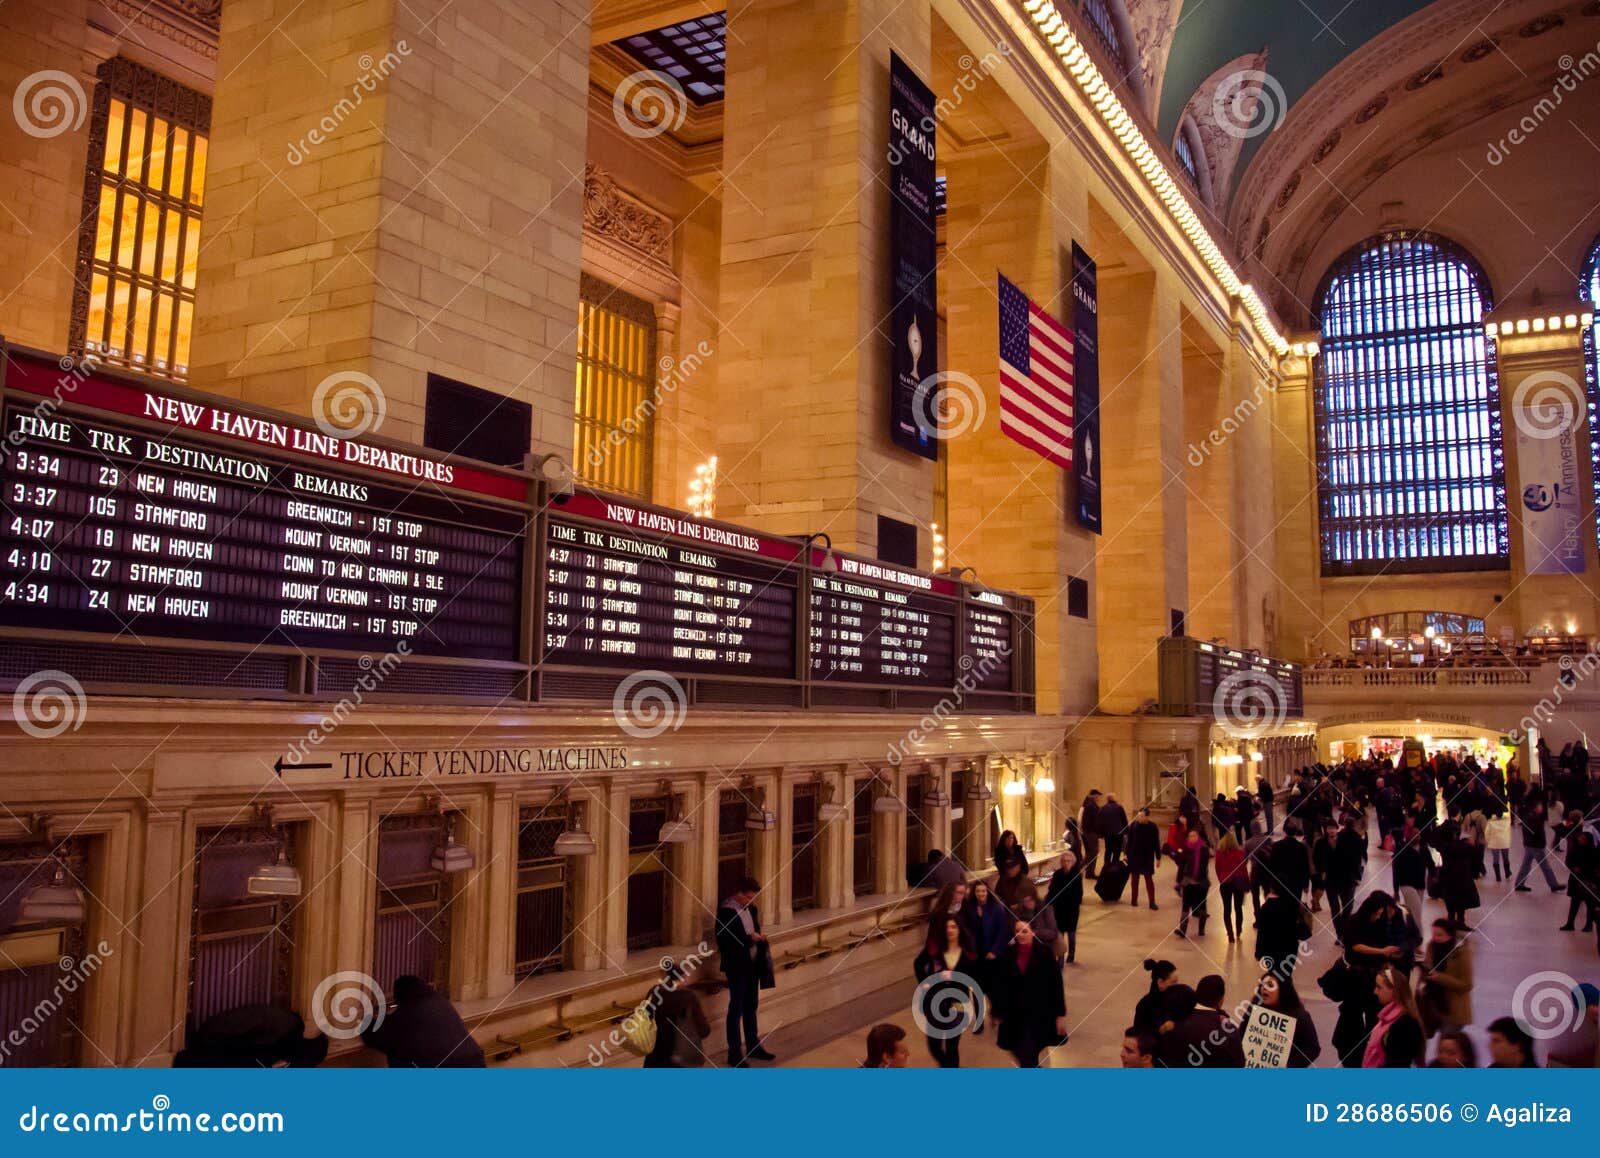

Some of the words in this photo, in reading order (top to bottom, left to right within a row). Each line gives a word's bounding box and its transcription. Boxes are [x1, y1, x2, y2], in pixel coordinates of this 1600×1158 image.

[892, 108, 935, 161] GRAND
[1073, 282, 1097, 313] GRAND
[16, 415, 71, 443] TIME
[88, 430, 133, 455] TRK
[145, 441, 270, 483] DESTINATION
[294, 473, 368, 502] REMARKS
[144, 393, 204, 426] NEW
[211, 409, 287, 447] HAVEN
[292, 428, 340, 458] LINE
[344, 441, 454, 484] DEPARTURES
[16, 452, 60, 476] 3:34
[99, 467, 118, 487] 23
[137, 473, 165, 494] NEW
[173, 480, 216, 504] HAVEN
[287, 501, 352, 527] GREENWICH
[372, 517, 391, 533] 1ST
[397, 522, 422, 538] STOP
[13, 484, 57, 507] 3:37
[89, 496, 116, 517] 105
[135, 504, 207, 530] STAMFORD
[285, 528, 322, 549] MOUNT
[329, 535, 371, 555] VERNON
[391, 545, 408, 561] 1ST
[414, 549, 439, 565] STOP
[607, 504, 635, 524] NEW
[638, 511, 676, 534] HAVEN
[678, 520, 701, 539] LINE
[703, 526, 759, 552] DEPARTURES
[11, 517, 54, 538] 4:07
[96, 528, 114, 547] 18
[132, 533, 160, 554] NEW
[168, 538, 213, 560] HAVEN
[283, 555, 314, 573] CONN
[322, 559, 336, 577] TO
[341, 563, 363, 581] NEW
[368, 567, 408, 586] CANAAN
[551, 525, 576, 542] TIME
[583, 531, 604, 547] TRK
[609, 536, 669, 560] DESTINATION
[679, 551, 717, 569] REMARKS
[8, 549, 51, 571] 4:10
[91, 558, 111, 578] 27
[130, 564, 202, 588] STAMFORD
[282, 582, 319, 601] MOUNT
[326, 588, 368, 607] VERNON
[388, 594, 407, 609] 1ST
[412, 598, 437, 614] STOP
[549, 569, 569, 584] 5:07
[603, 578, 617, 592] NEW
[620, 581, 641, 595] HAVEN
[674, 590, 704, 604] STAMFORD
[726, 598, 740, 609] STOP
[550, 548, 569, 563] 4:37
[586, 555, 595, 568] 21
[603, 558, 638, 575] STAMFORD
[739, 582, 753, 594] STOP
[812, 577, 827, 589] TIME
[830, 581, 842, 593] TRK
[845, 583, 878, 600] DESTINATION
[842, 558, 858, 574] NEW
[859, 563, 881, 579] HAVEN
[882, 568, 896, 581] LINE
[897, 571, 932, 589] DEPARTURES
[4, 582, 49, 603] 4:34
[88, 590, 109, 608] 24
[127, 593, 156, 614] NEW
[165, 597, 209, 618] HAVEN
[280, 609, 346, 630] GREENWICH
[367, 618, 386, 633] 1ST
[392, 620, 418, 636] STOP
[547, 613, 568, 627] 5:34
[585, 618, 594, 630] 18
[602, 619, 616, 632] NEW
[619, 621, 640, 635] HAVEN
[728, 633, 742, 645] STOP
[548, 592, 568, 606] 5:10
[581, 596, 595, 609] 110
[602, 599, 637, 615] STAMFORD
[739, 617, 752, 629] STOP
[546, 635, 567, 648] 5:37
[584, 638, 593, 650] 17
[601, 640, 636, 654] STAMFORD
[738, 652, 752, 663] STOP
[340, 750, 427, 780] TICKET
[433, 748, 532, 775] VENDING
[536, 746, 628, 772] MACHINES
[1248, 1025, 1269, 1038] SMALL
[1248, 1035, 1262, 1046] CAN
[1259, 1012, 1288, 1033] ONE
[1247, 1049, 1255, 1058] A
[1261, 1049, 1280, 1067] BIG
